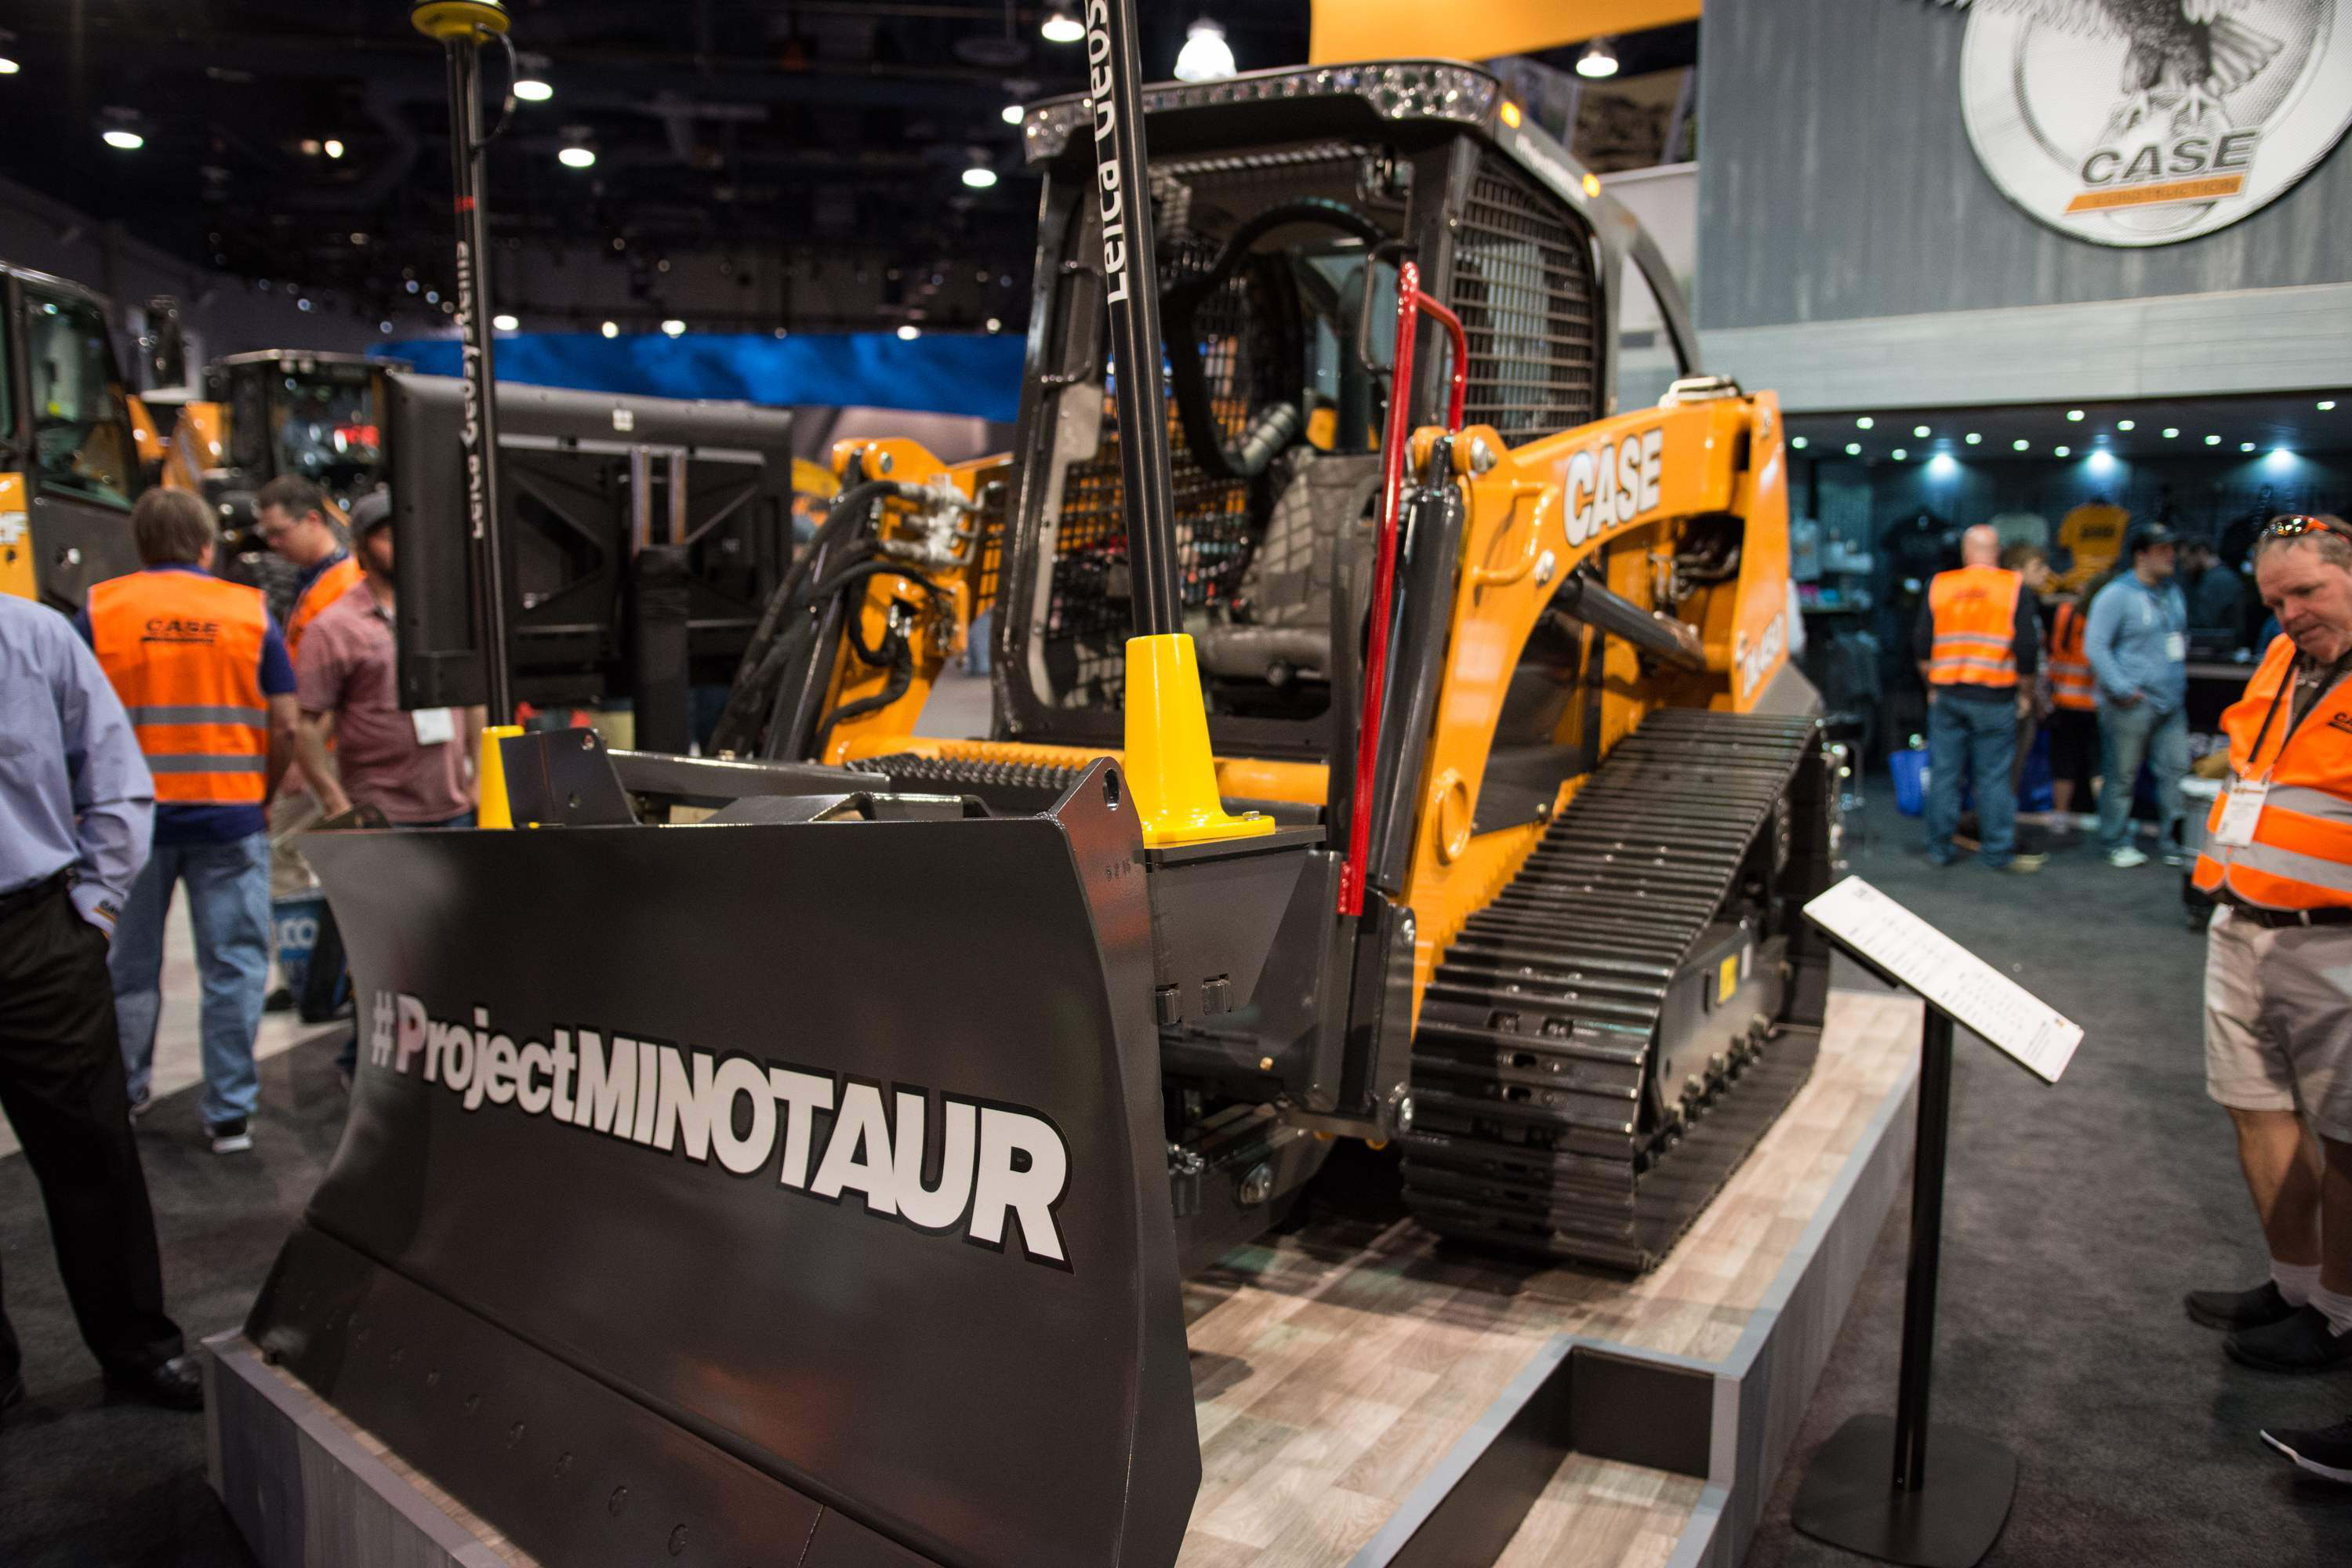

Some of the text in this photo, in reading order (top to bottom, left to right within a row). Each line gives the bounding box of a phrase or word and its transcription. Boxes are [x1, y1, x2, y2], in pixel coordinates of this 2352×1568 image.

[2081, 131, 2257, 184] CASE
[1098, 159, 1129, 305] Leica
[1563, 428, 1663, 547] CASE
[146, 619, 220, 634] CASE
[371, 990, 1067, 1263] #ProjectMINOTAUR
